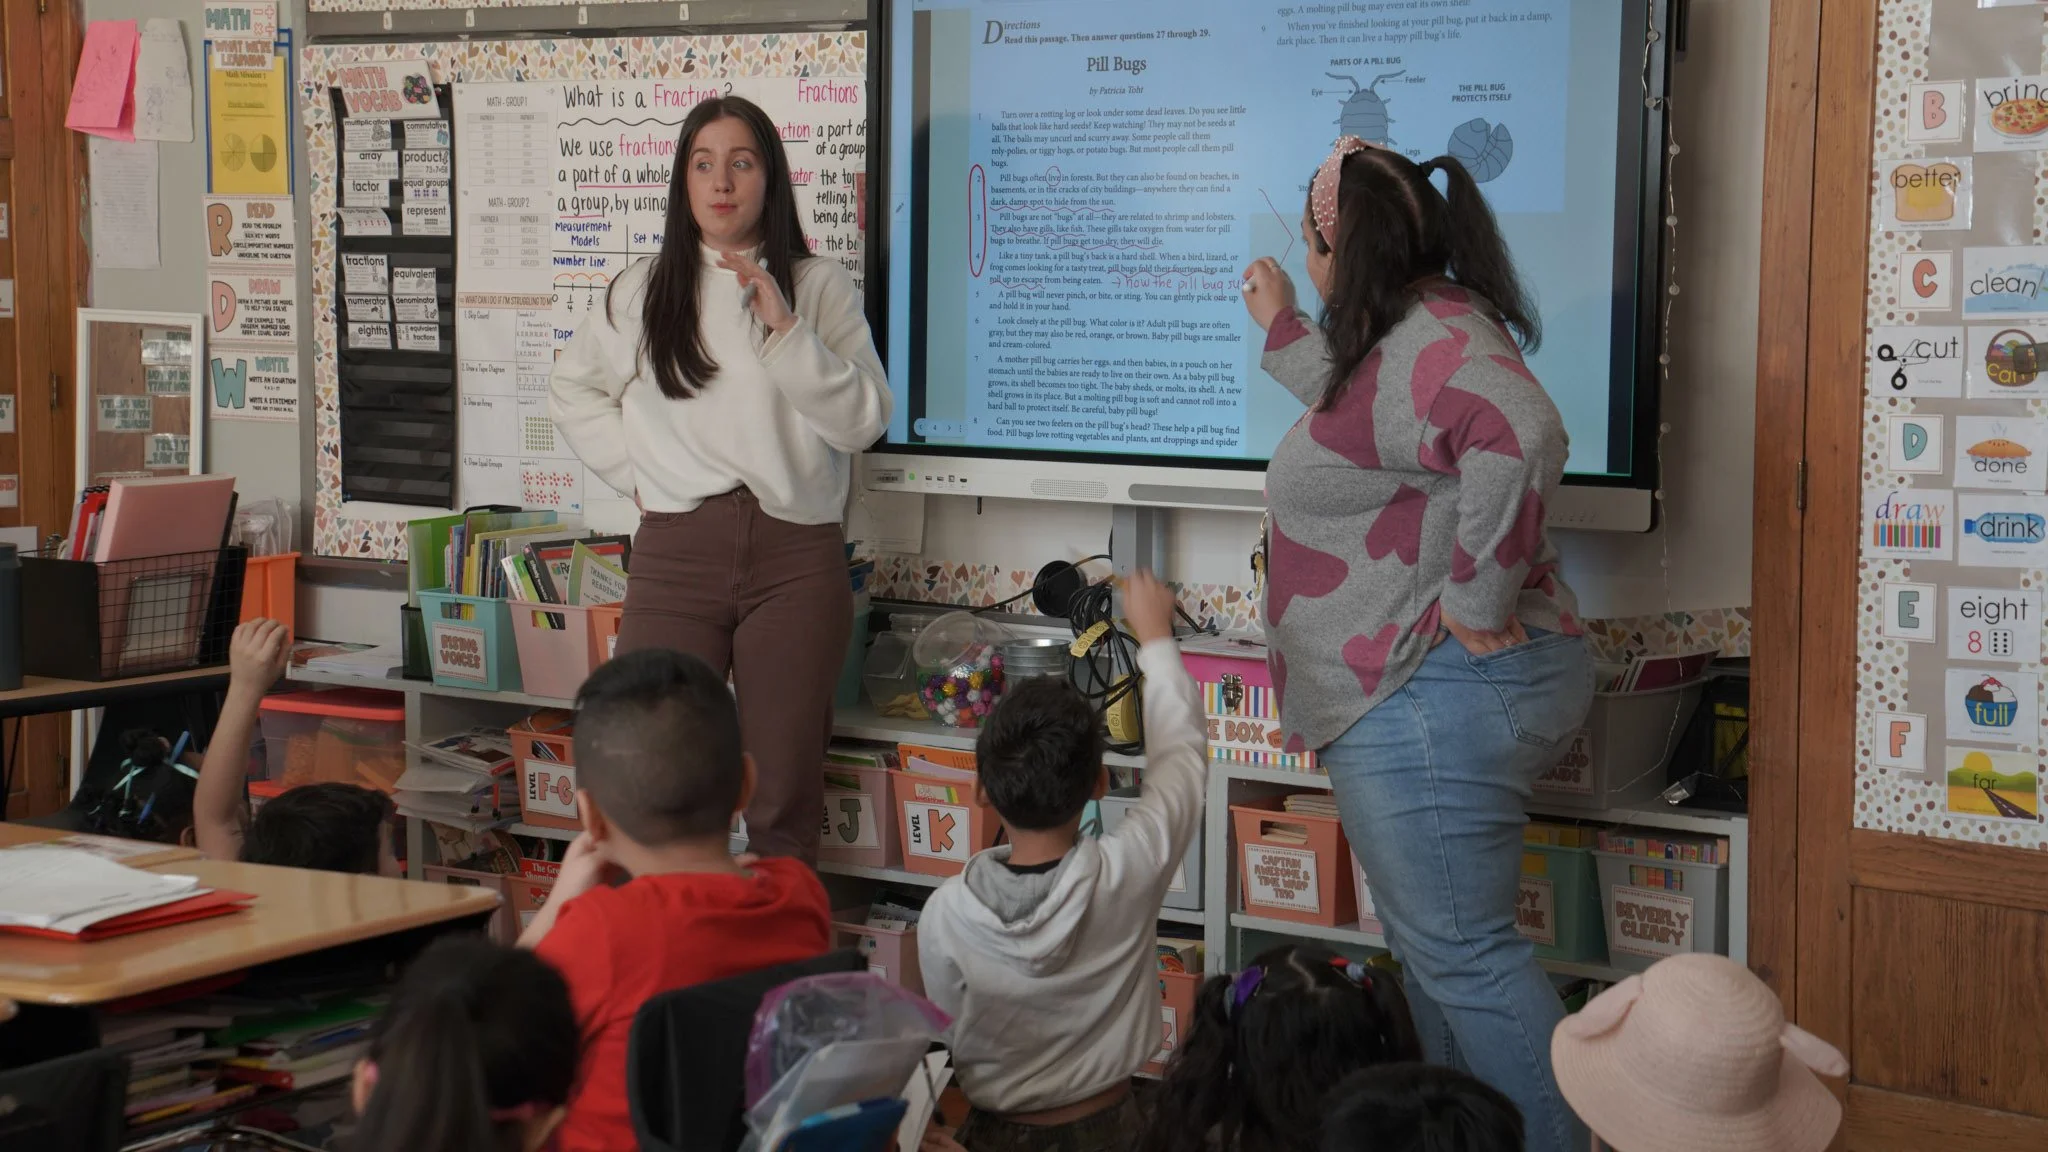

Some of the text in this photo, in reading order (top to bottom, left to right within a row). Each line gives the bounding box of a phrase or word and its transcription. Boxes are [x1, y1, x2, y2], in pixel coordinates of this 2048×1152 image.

[206, 8, 250, 31] MATH
[1025, 35, 1038, 43] this
[1040, 36, 1069, 44] passage.
[1071, 34, 1089, 42] Then
[1120, 32, 1154, 41] questions
[1156, 30, 1165, 38] 27
[1167, 29, 1197, 39] through
[1200, 29, 1210, 37] 29.
[215, 40, 242, 53] WHAT
[221, 54, 266, 67] LEARNING
[1087, 56, 1147, 75] Pill Bugs
[339, 67, 388, 88] MATH
[563, 84, 603, 109] What
[612, 87, 624, 107] is
[635, 91, 647, 108] a
[798, 80, 858, 104] Fractions
[1089, 87, 1097, 96] by
[1100, 86, 1125, 95] Patricia
[1312, 88, 1323, 97] Eye
[345, 91, 402, 113] VOCAB
[1923, 90, 1946, 130] B
[406, 122, 447, 130] commutative
[817, 126, 823, 137] a
[828, 119, 852, 141] part
[856, 120, 866, 136] of
[360, 152, 382, 161] array
[560, 137, 582, 157] We
[590, 140, 613, 157] use
[816, 142, 865, 160] of a group
[1405, 149, 1420, 157] Legs
[404, 151, 443, 164] product
[353, 180, 380, 192] factor
[404, 179, 448, 188] equal groups
[558, 162, 670, 191] a part of a whole
[821, 168, 837, 186] the
[1894, 168, 1960, 189] better
[558, 198, 566, 212] a
[616, 194, 629, 215] by
[634, 193, 667, 217] using
[816, 190, 847, 206] telling
[407, 206, 446, 217] represent
[814, 209, 837, 228] being
[207, 202, 275, 256] R READ
[555, 221, 612, 232] Measurement
[571, 235, 600, 246] Models
[634, 233, 646, 244] Set
[826, 235, 843, 251] the
[346, 256, 385, 266] fractions
[553, 255, 586, 267] Number
[394, 269, 436, 279] equivalent
[1912, 259, 1938, 298] C
[1126, 278, 1149, 288] how
[1152, 277, 1172, 288] the
[1178, 278, 1197, 295] pill
[1202, 276, 1223, 298] bug
[1970, 272, 2038, 300] clean
[212, 279, 281, 332] D DRAW
[347, 296, 386, 305] numerator
[358, 325, 388, 337] eighths
[553, 329, 574, 341] Tape
[1915, 336, 1959, 359] cut
[211, 358, 247, 409] W
[255, 357, 289, 373] WRITE
[996, 417, 1010, 425] Can
[1011, 418, 1024, 427] you
[1052, 418, 1073, 428] feelers
[1085, 420, 1096, 428] the
[1098, 421, 1109, 431] pill
[1110, 421, 1129, 431] bug's
[1130, 422, 1150, 431] head?
[1152, 423, 1172, 432] These
[1174, 424, 1189, 434] help
[1196, 425, 1208, 435] pill
[1210, 425, 1224, 435] bug
[1225, 426, 1240, 435] find
[1903, 422, 1928, 461] D
[1974, 457, 2027, 474] done
[1876, 491, 1945, 520] draw
[1980, 517, 2041, 538] drink
[1899, 591, 1920, 628] E
[1960, 596, 2028, 624] eight
[441, 634, 478, 653] RISING
[1968, 630, 1982, 653] 8
[440, 650, 480, 669] VOICES
[1974, 702, 2008, 726] full
[1225, 720, 1265, 744] BOX
[1890, 721, 1911, 757] F
[1972, 774, 1997, 791] far
[838, 798, 861, 843] J
[911, 809, 956, 852] LEVEL K
[532, 862, 545, 872] The
[1262, 855, 1301, 869] CAPTAIN
[1254, 864, 1310, 881] AWESOME &
[1258, 875, 1308, 891] TIME WARP
[1273, 888, 1295, 899] TRIO
[1615, 900, 1689, 930] BEVERLY
[1620, 919, 1684, 946] CLEARY
